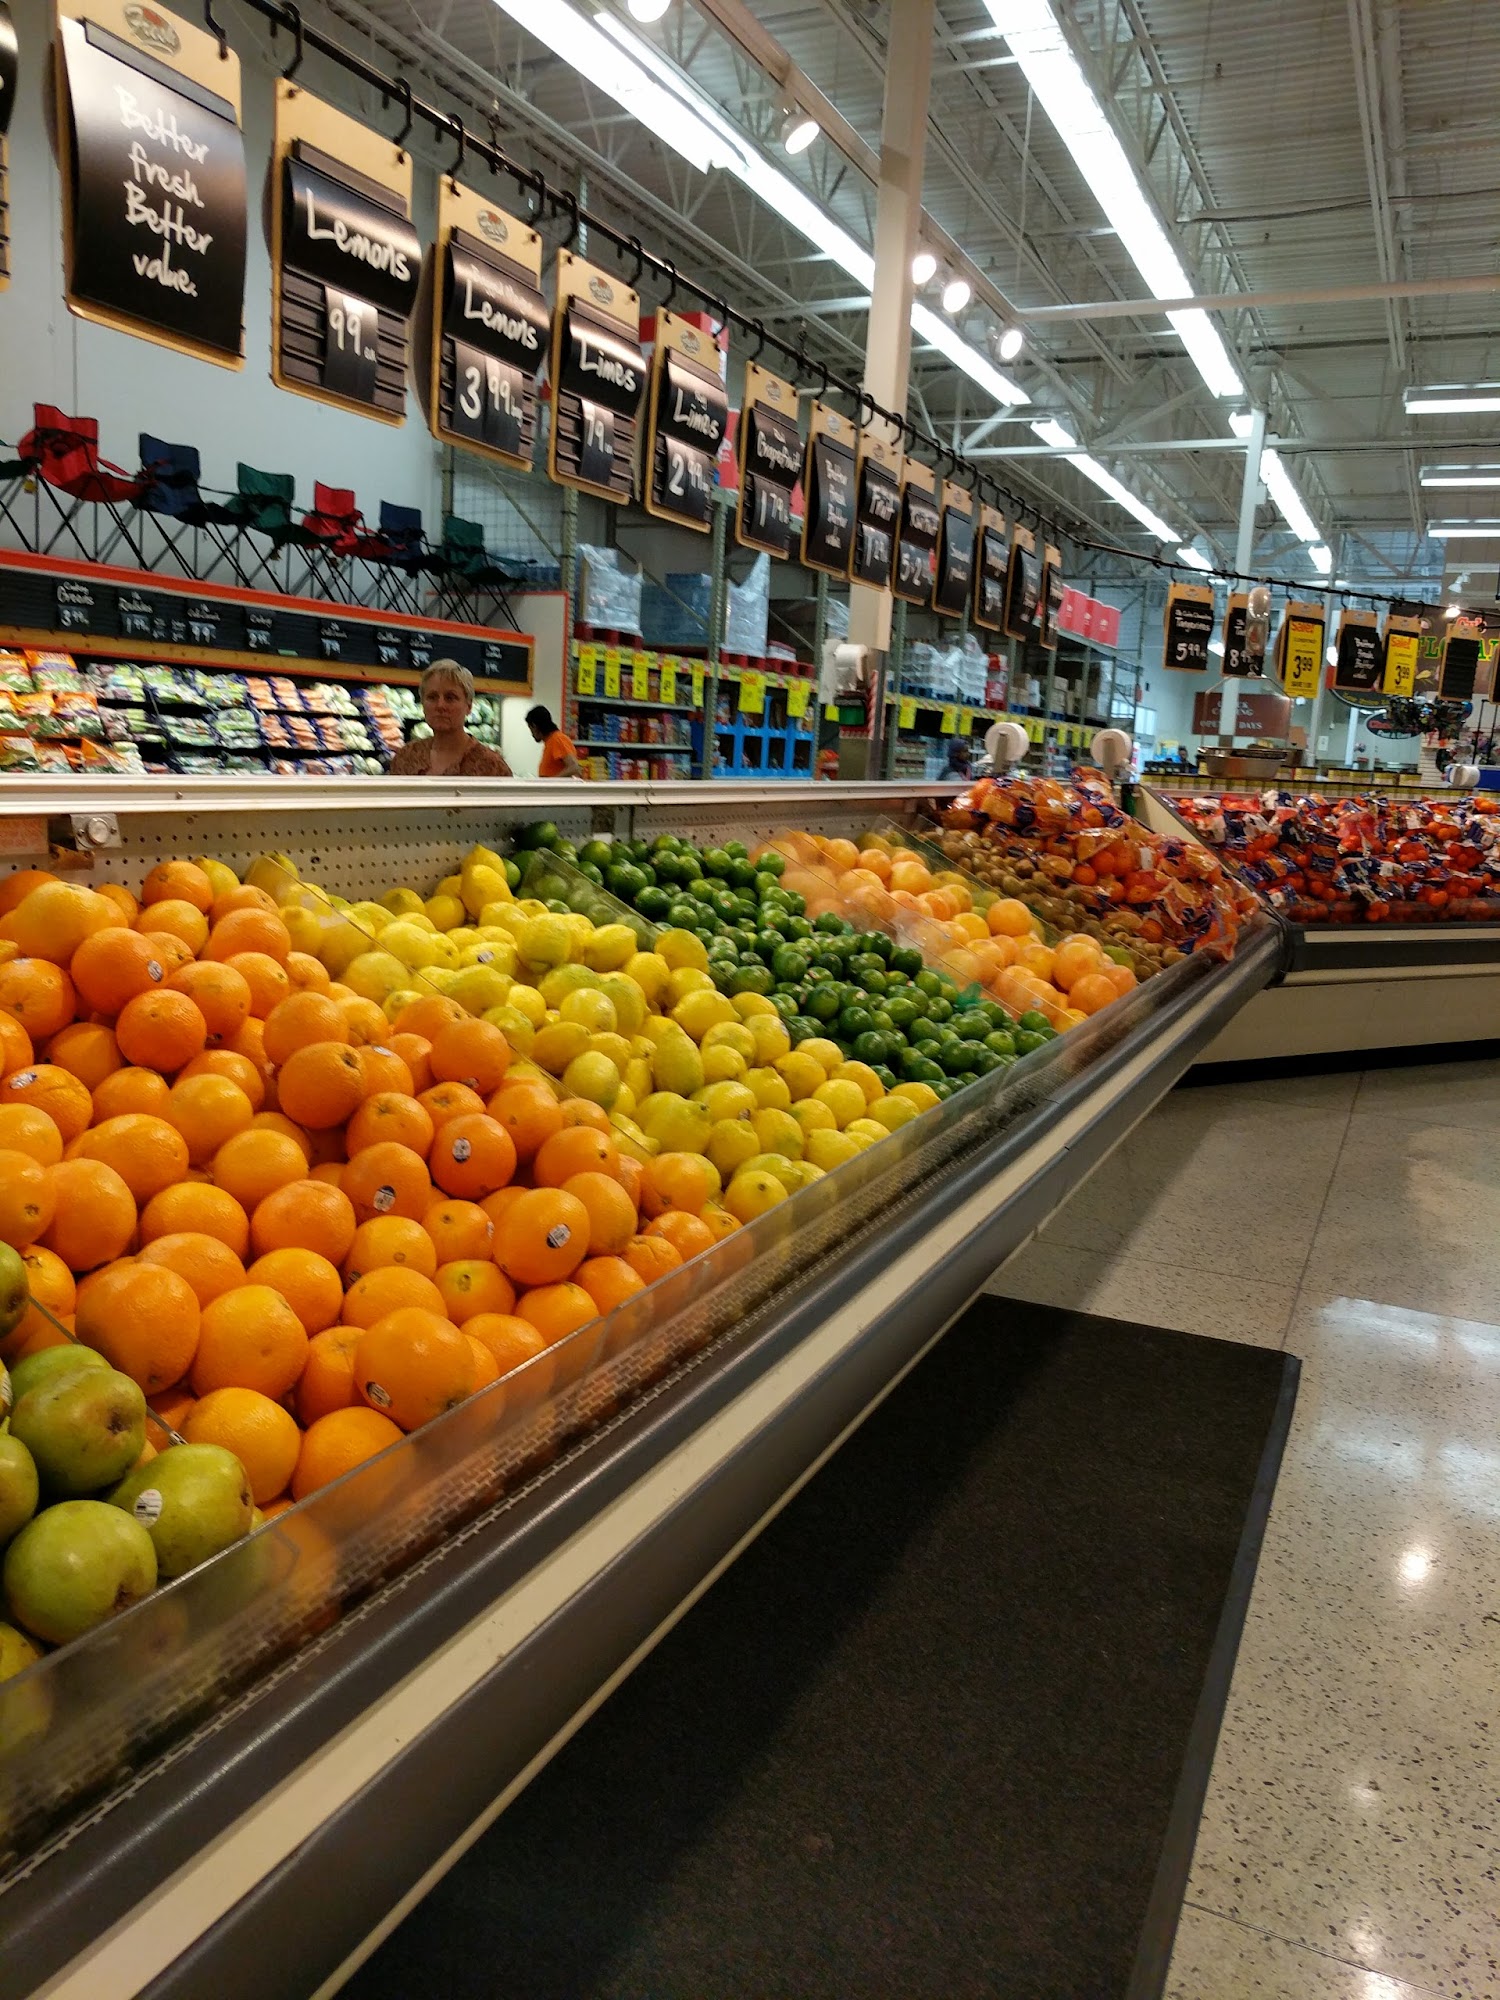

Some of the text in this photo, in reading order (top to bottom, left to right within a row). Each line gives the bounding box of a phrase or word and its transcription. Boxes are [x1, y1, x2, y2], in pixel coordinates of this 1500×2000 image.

[114, 84, 210, 165] Better
[122, 179, 214, 256] Better
[305, 186, 412, 283] Lemons
[463, 278, 539, 351] Lemons
[579, 338, 637, 393] Limes
[672, 387, 721, 441] Limes
